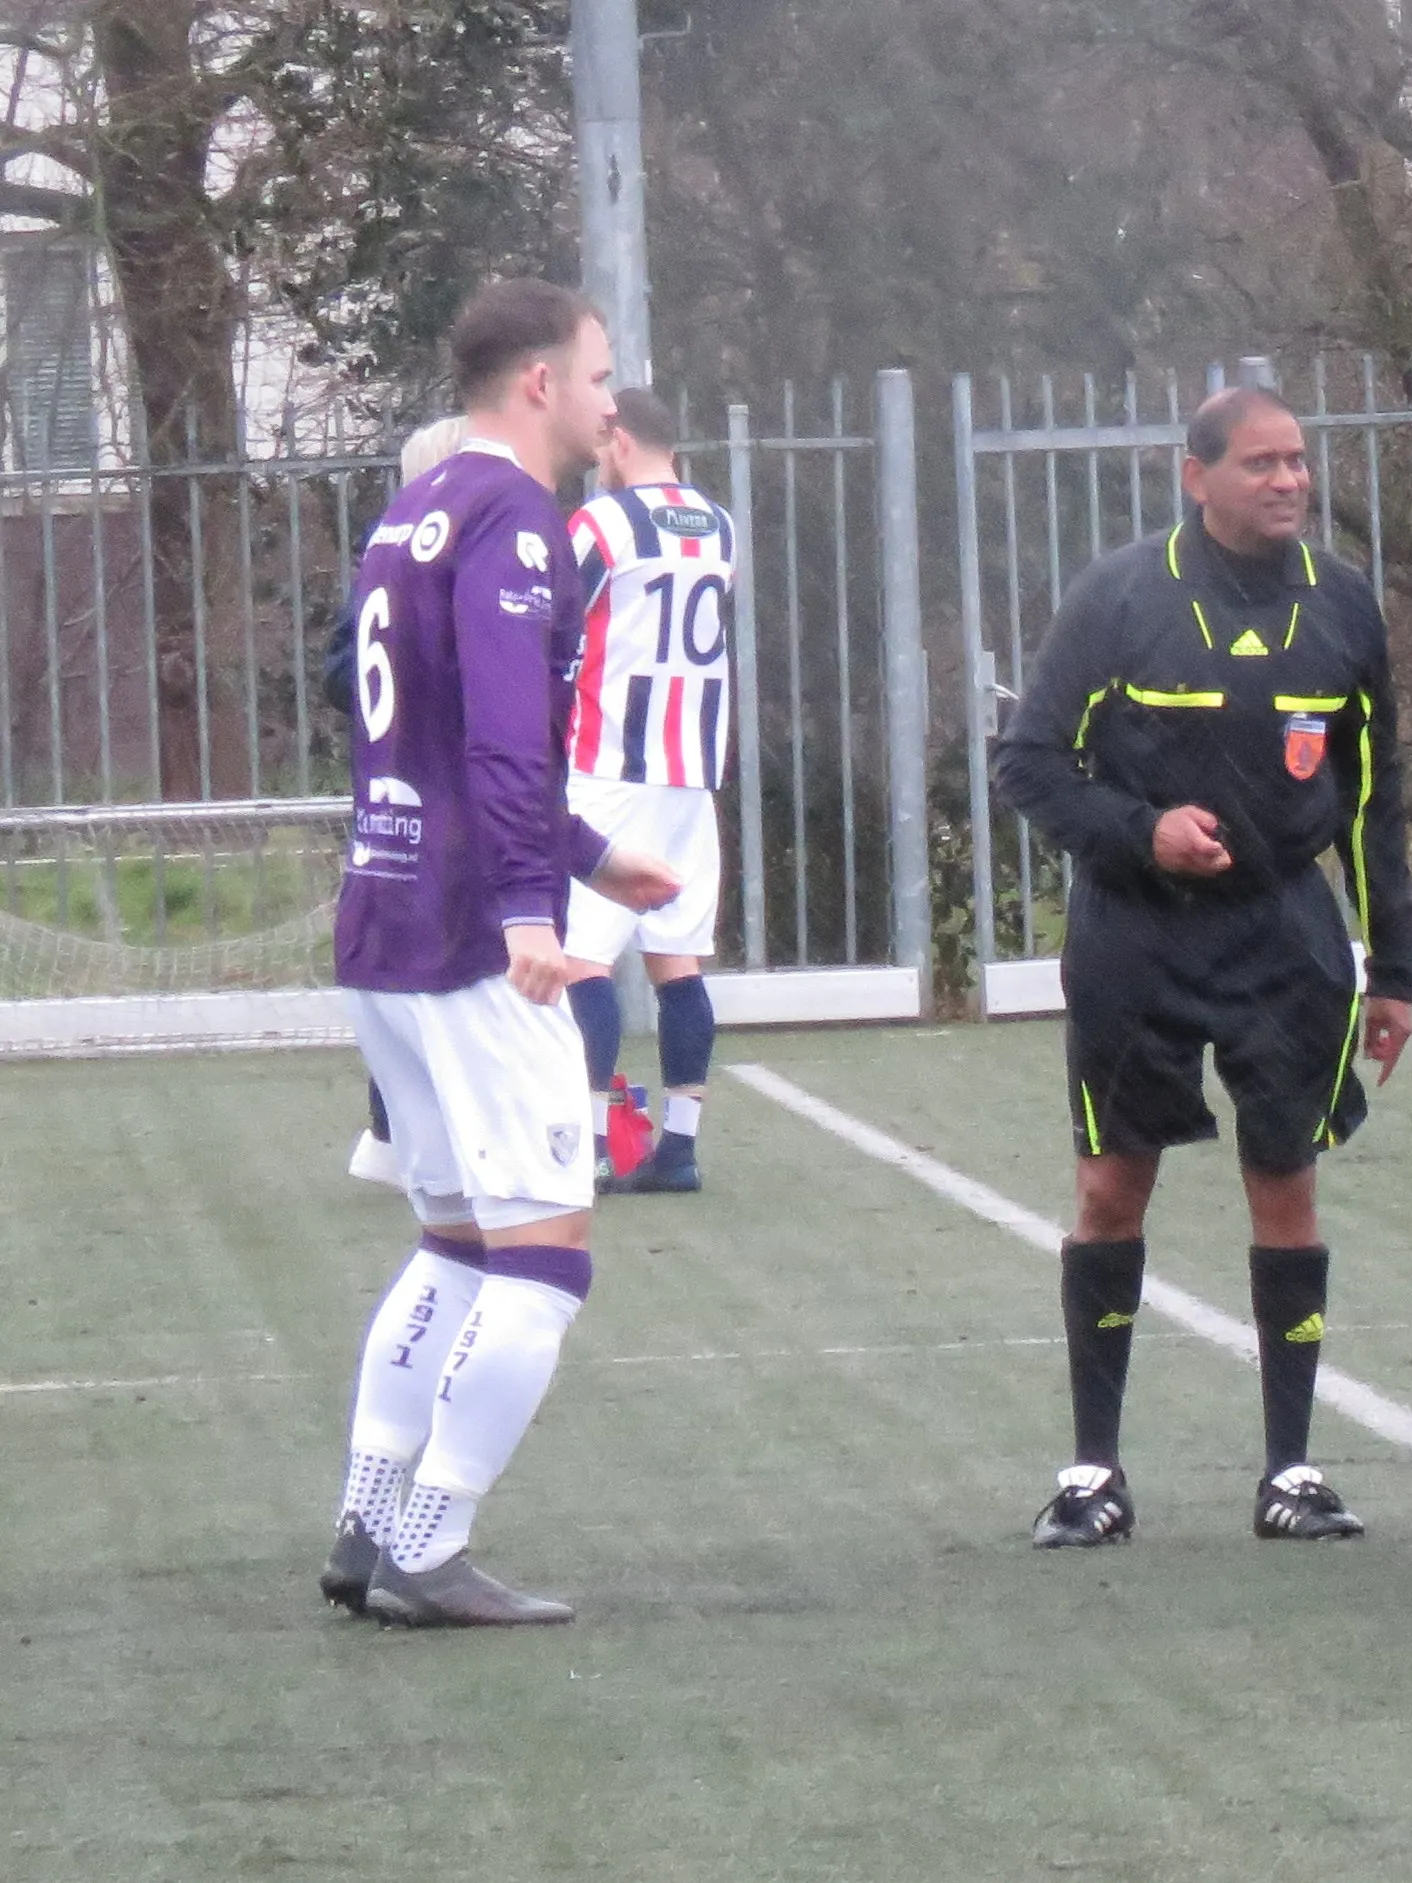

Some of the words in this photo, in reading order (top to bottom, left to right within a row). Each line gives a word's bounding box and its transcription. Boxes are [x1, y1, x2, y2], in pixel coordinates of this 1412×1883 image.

[358, 587, 395, 743] 6
[644, 572, 726, 666] 10
[438, 1310, 483, 1402] 1971
